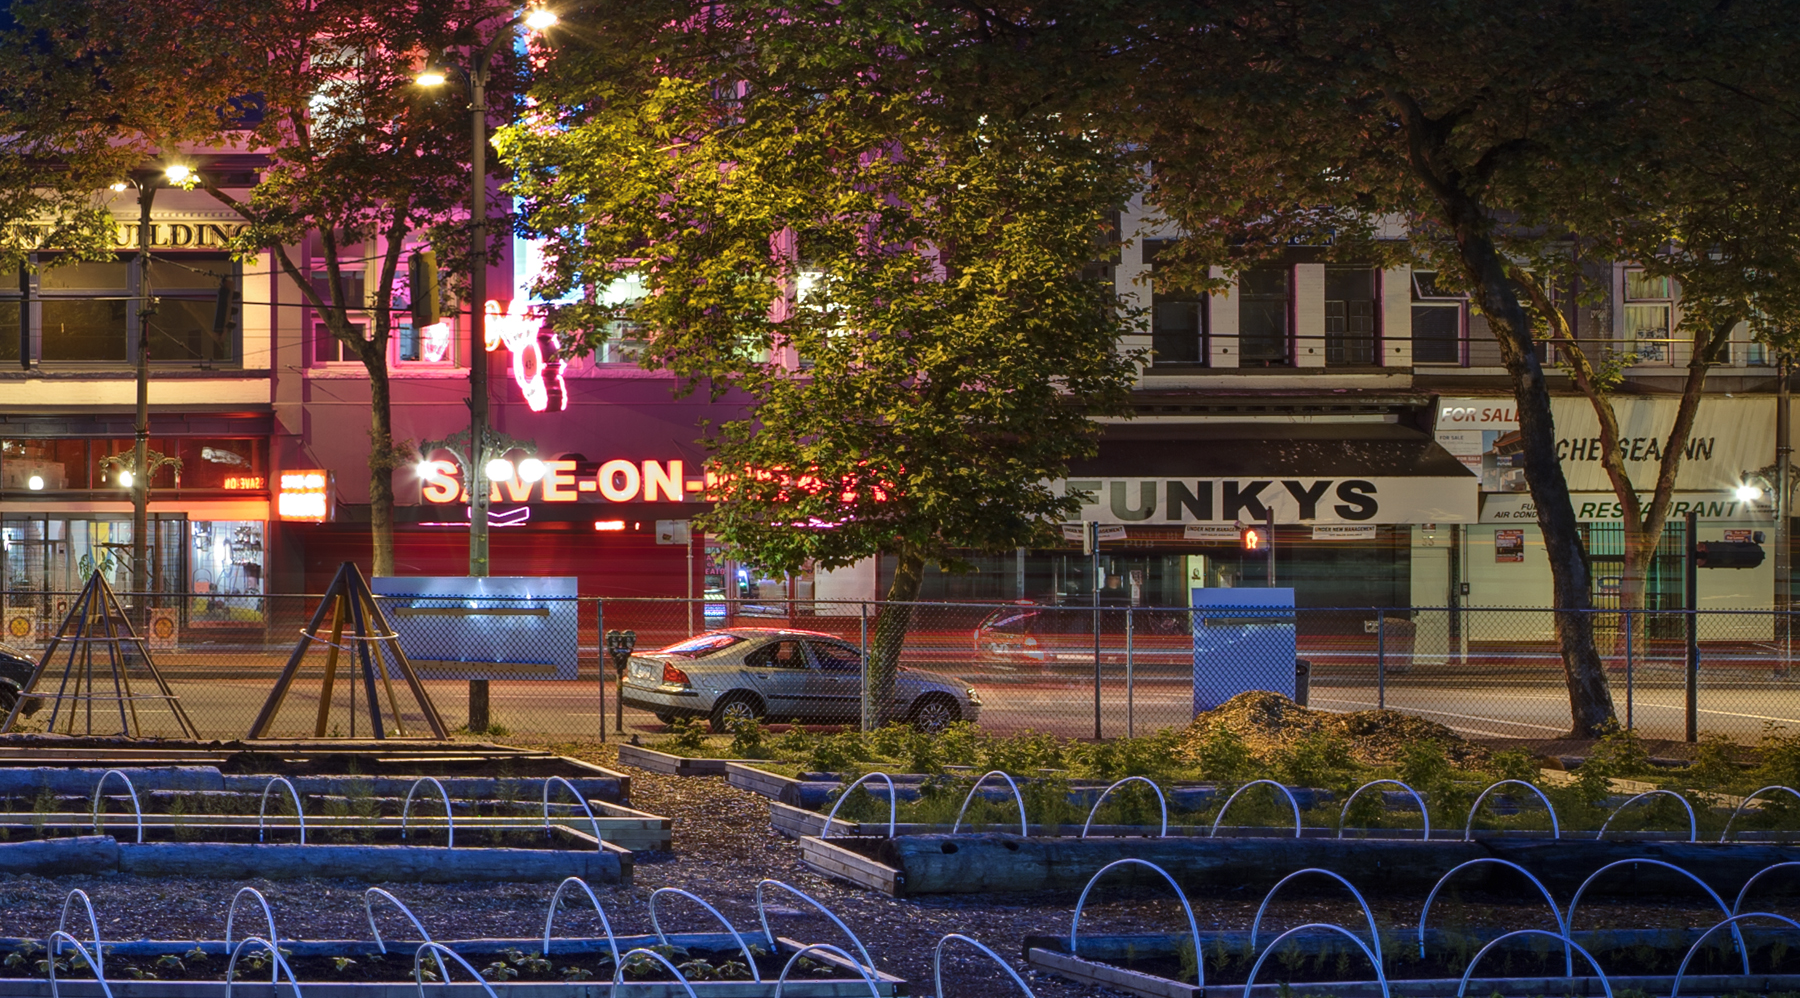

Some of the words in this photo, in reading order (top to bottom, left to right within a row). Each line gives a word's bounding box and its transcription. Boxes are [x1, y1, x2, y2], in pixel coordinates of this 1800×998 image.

[96, 223, 253, 248] UILDIN
[1442, 407, 1477, 422] FOR
[1678, 437, 1715, 461] NN
[1065, 480, 1378, 522] FUNKYS
[1579, 501, 1739, 519] RESRANT
